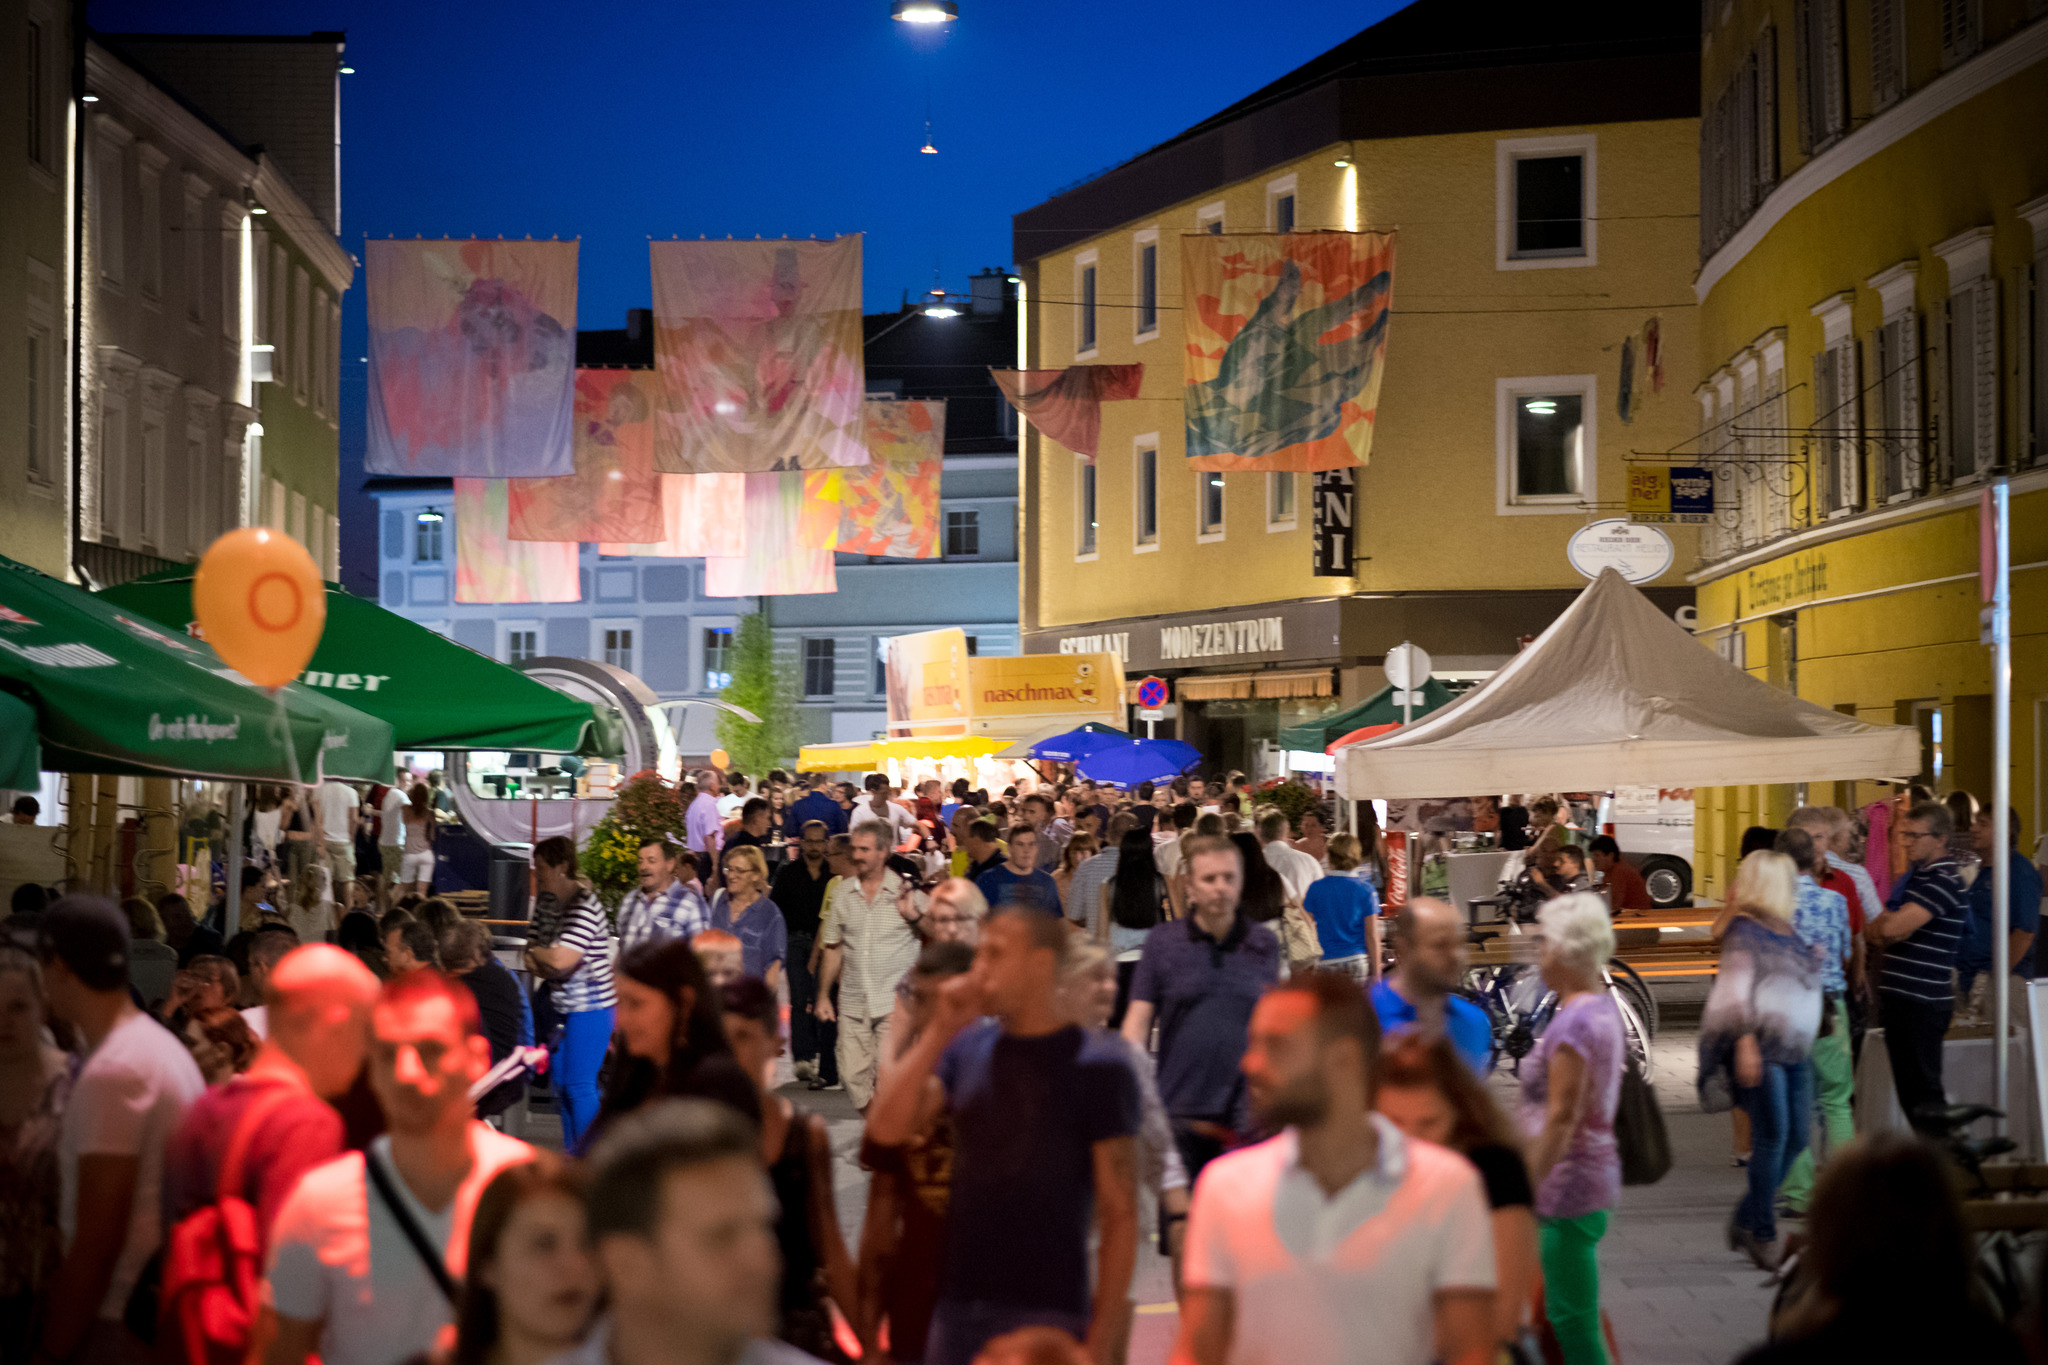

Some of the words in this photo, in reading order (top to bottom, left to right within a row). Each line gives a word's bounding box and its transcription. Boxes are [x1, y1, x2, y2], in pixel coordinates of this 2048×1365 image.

[1631, 513, 1676, 523] RIEDER
[1680, 514, 1709, 523] BIER
[1160, 616, 1284, 660] MODEZENTRUM
[983, 683, 1075, 703] naschmax
